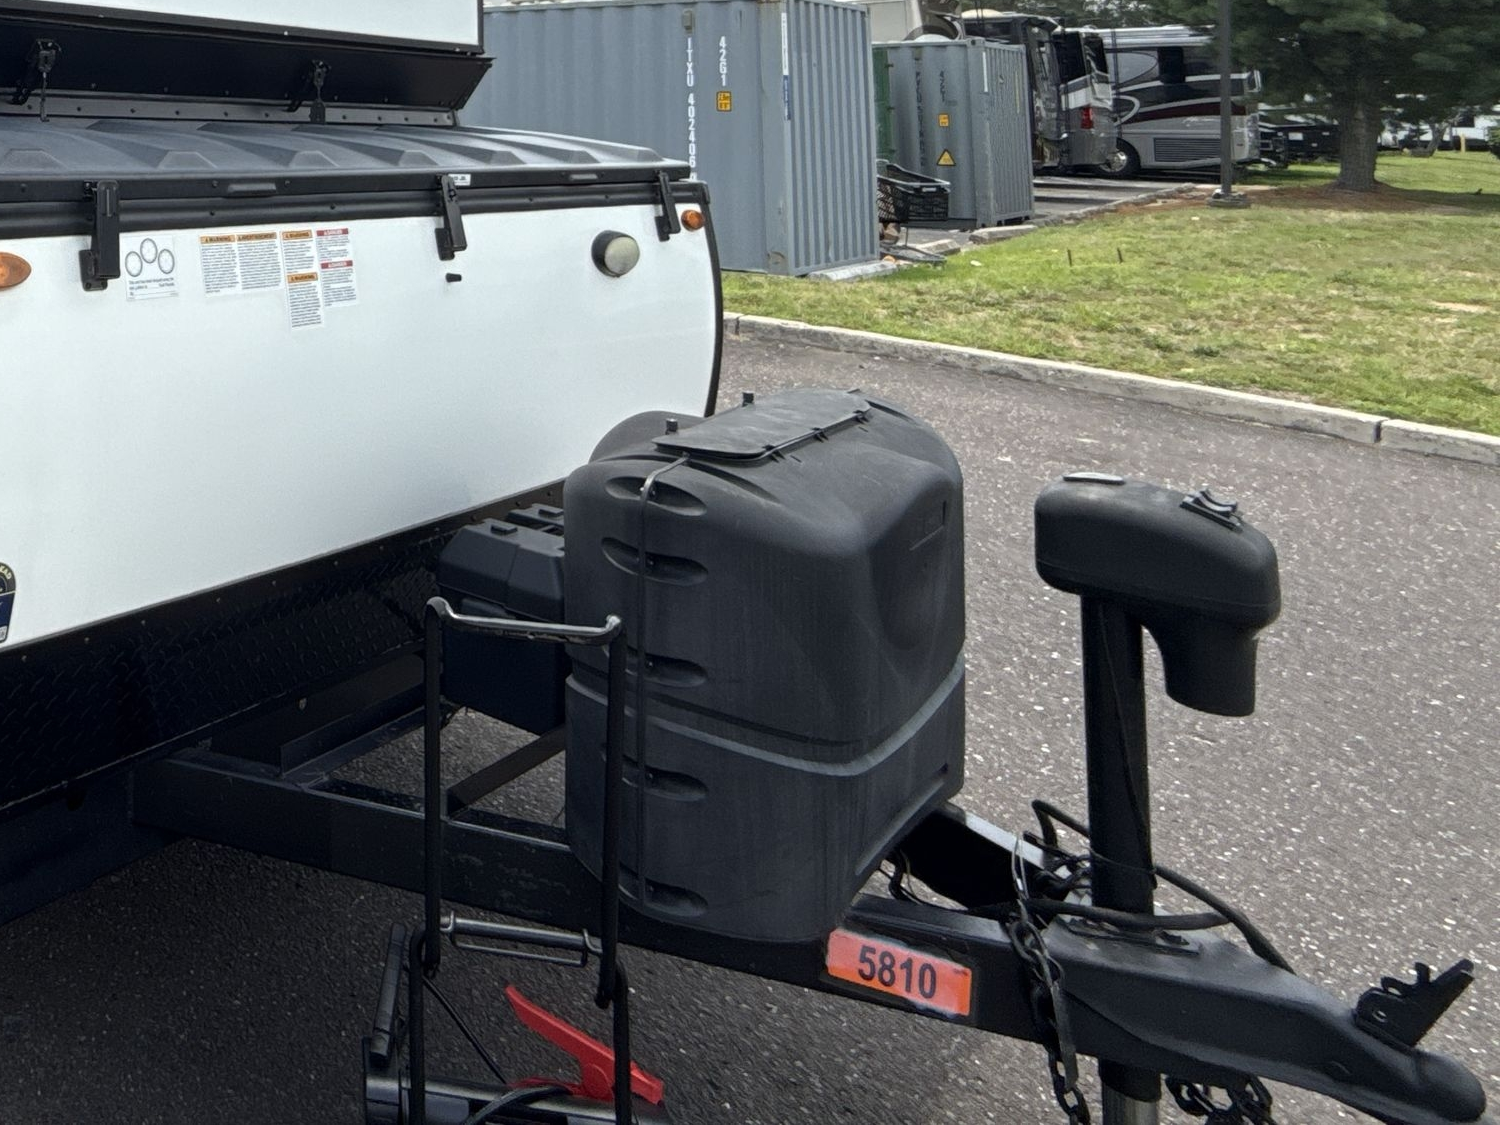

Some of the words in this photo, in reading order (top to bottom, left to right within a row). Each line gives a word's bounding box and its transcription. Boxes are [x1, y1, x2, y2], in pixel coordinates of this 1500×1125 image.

[686, 37, 695, 87] ITXU
[718, 36, 728, 87] 42G1
[687, 93, 697, 168] 402406
[858, 945, 937, 999] 5810
